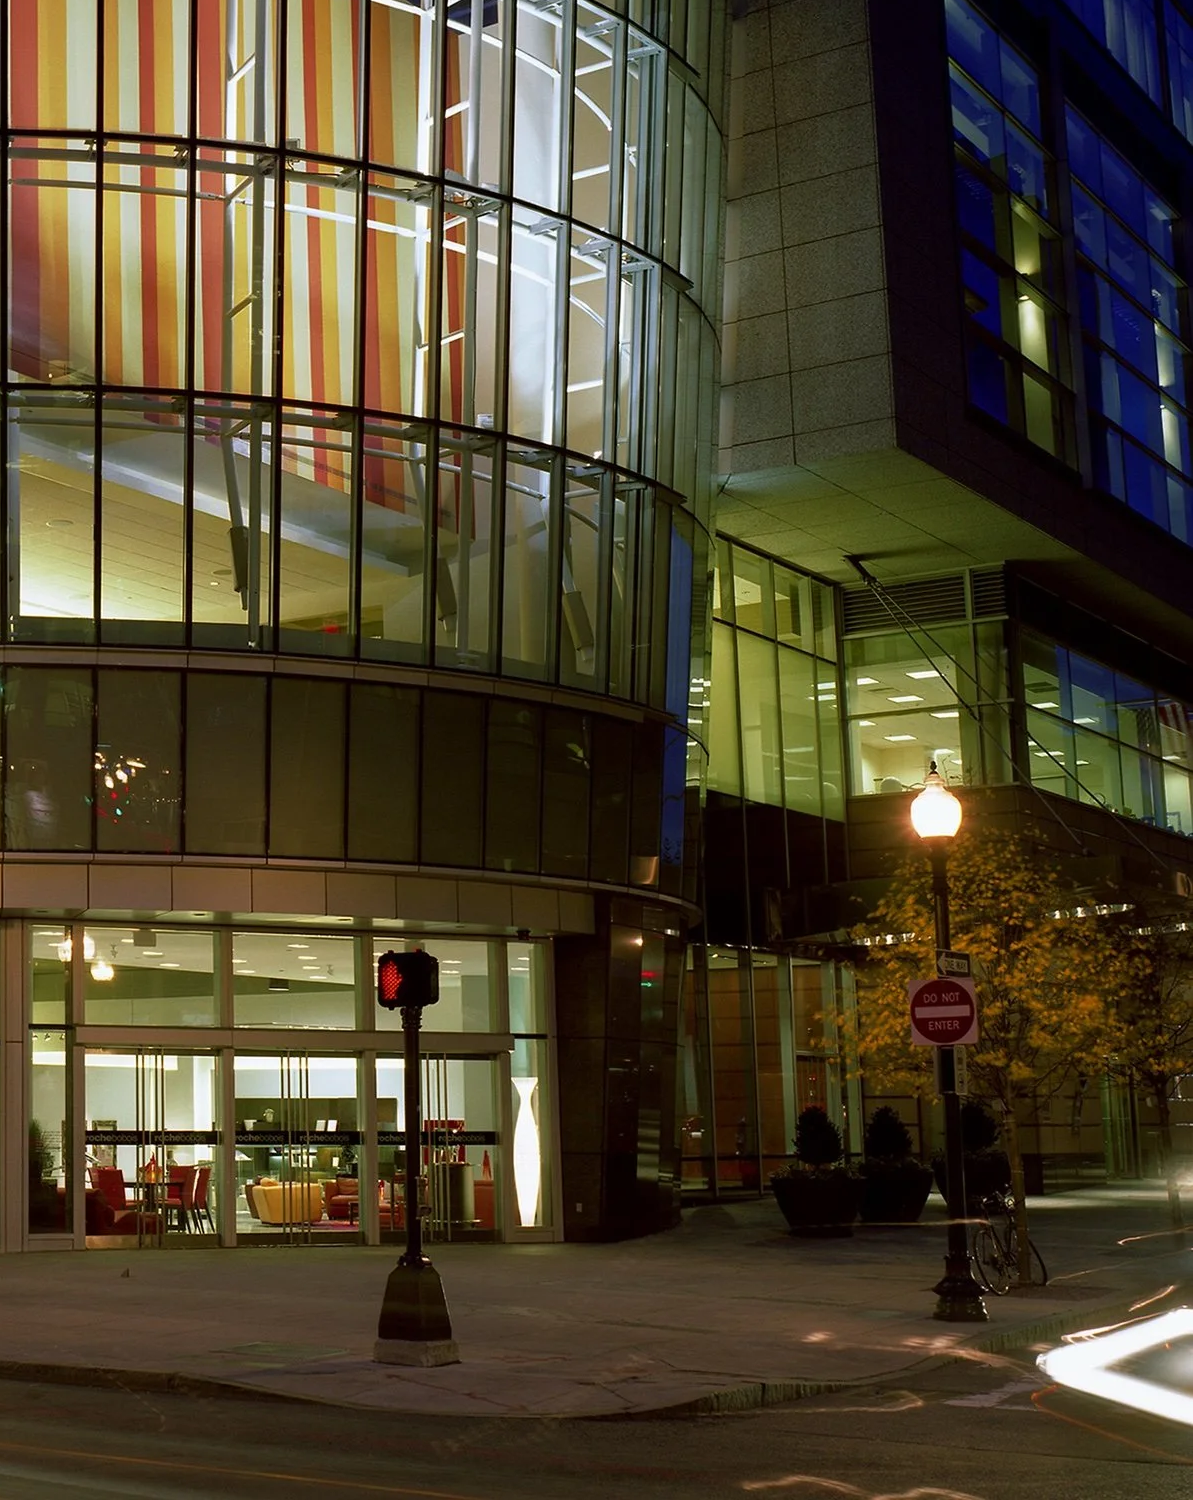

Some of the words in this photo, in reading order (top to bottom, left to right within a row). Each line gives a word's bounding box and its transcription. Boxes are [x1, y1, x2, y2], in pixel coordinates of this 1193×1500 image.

[923, 993, 938, 1003] DO
[941, 992, 960, 1003] NOT
[928, 1020, 960, 1031] ENTER
